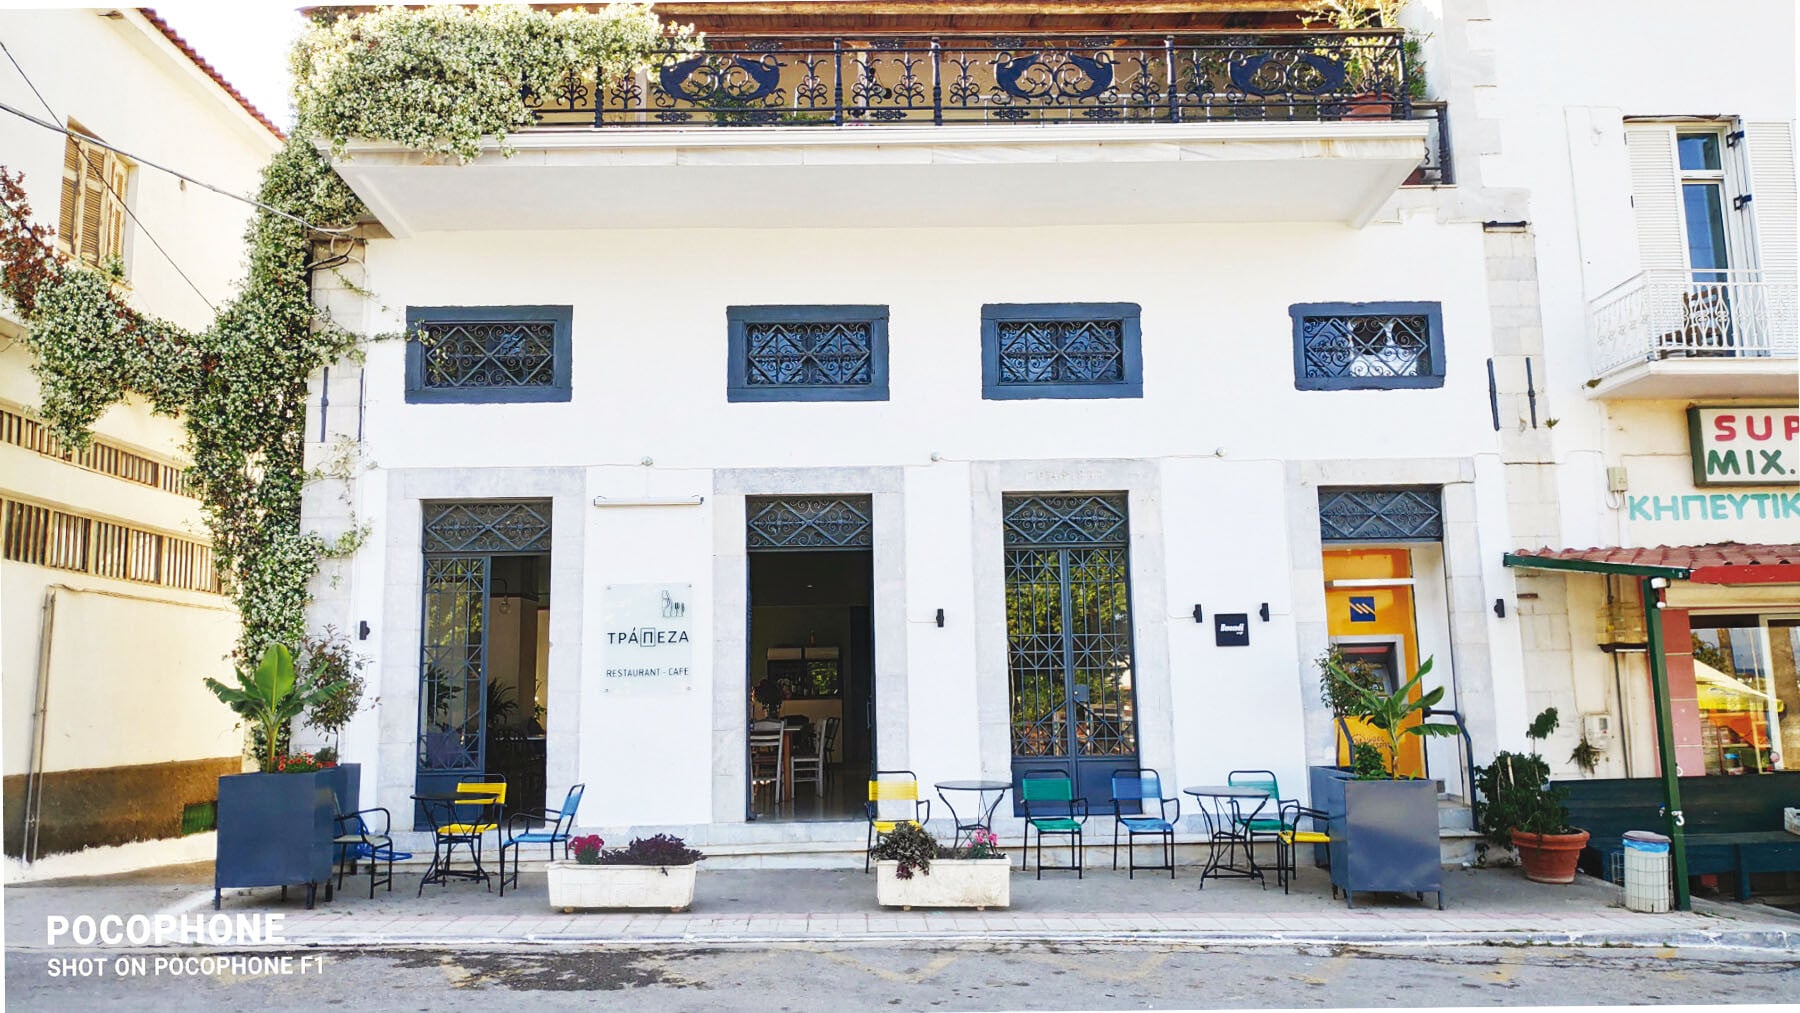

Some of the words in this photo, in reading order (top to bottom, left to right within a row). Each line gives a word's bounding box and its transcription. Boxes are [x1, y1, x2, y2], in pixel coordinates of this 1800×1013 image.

[1628, 492, 1800, 521] ΚΗΠΕΥΤΙΚ
[606, 668, 660, 678] RESTAURANT
[668, 667, 688, 676] CAFE
